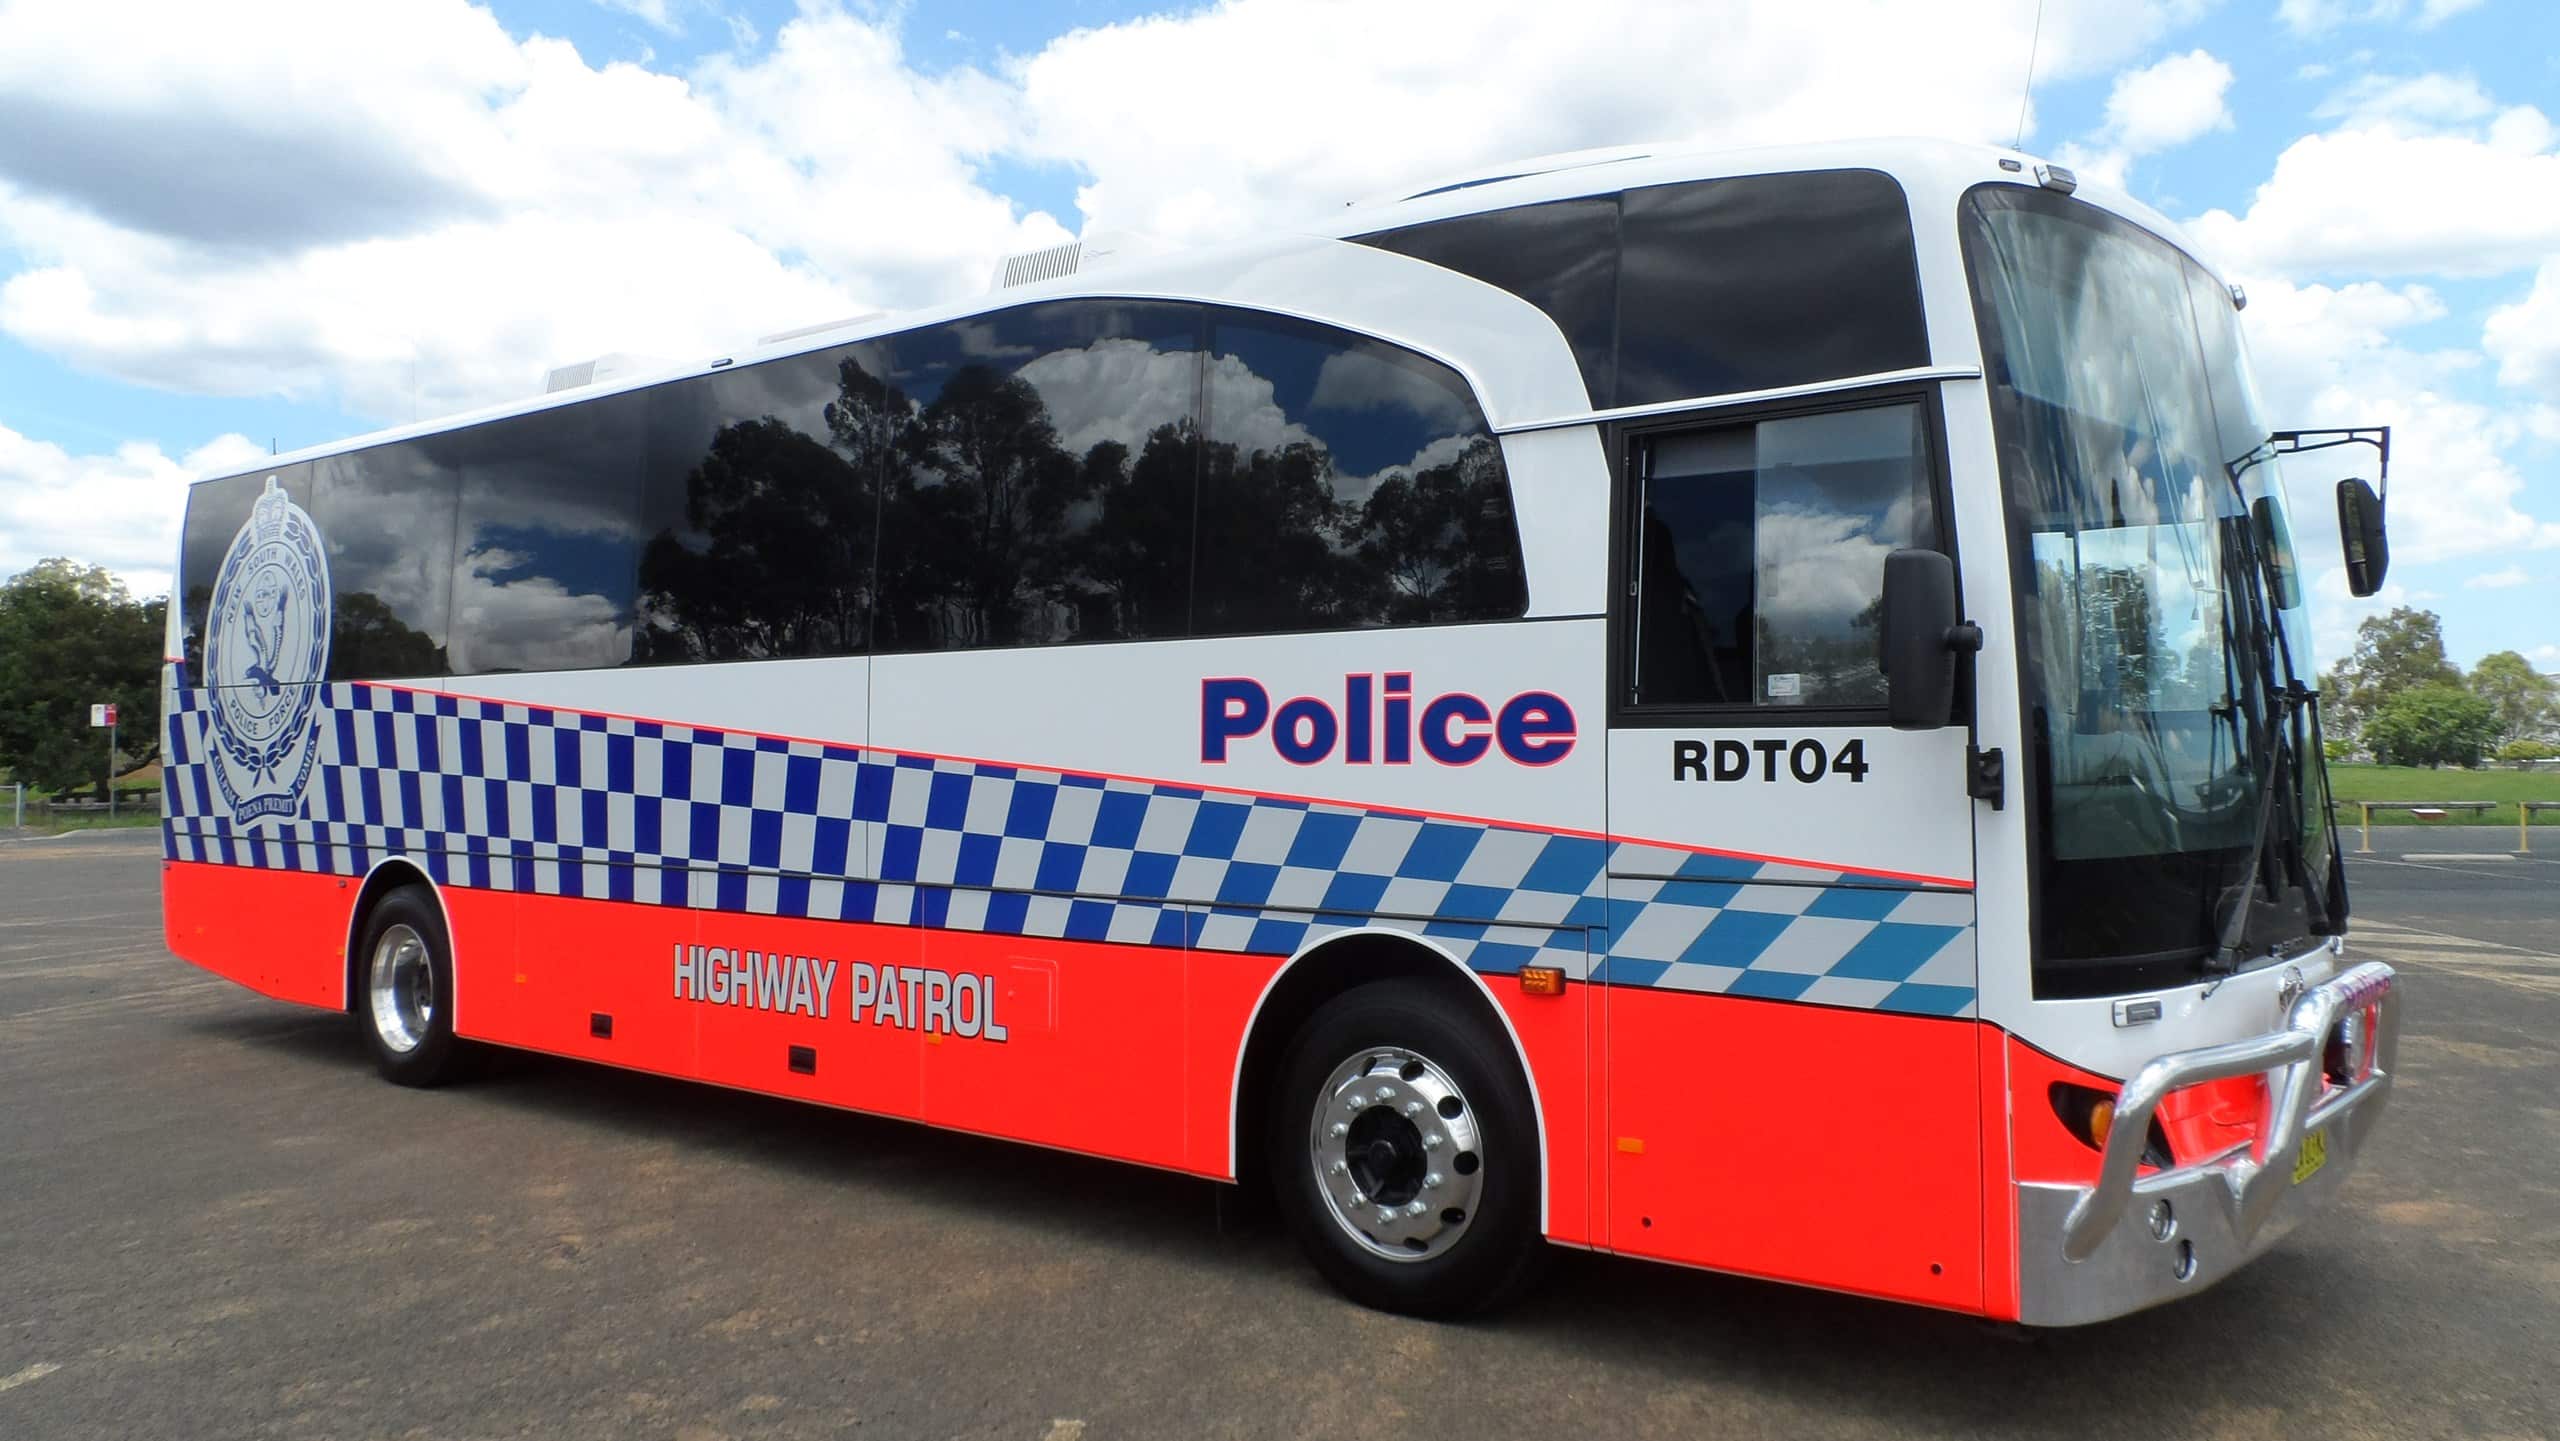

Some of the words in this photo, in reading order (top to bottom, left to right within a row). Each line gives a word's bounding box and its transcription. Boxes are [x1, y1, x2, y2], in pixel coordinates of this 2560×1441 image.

[228, 584, 242, 624] NEW
[248, 547, 277, 576] SOUTH
[284, 550, 306, 601] WALES
[230, 698, 259, 736] POLICE
[267, 686, 296, 731] FORCE
[1200, 671, 1577, 768] Police
[1673, 738, 1869, 784] RDT04
[673, 943, 838, 1019] HIGHWAY
[850, 961, 1009, 1042] PATROL
